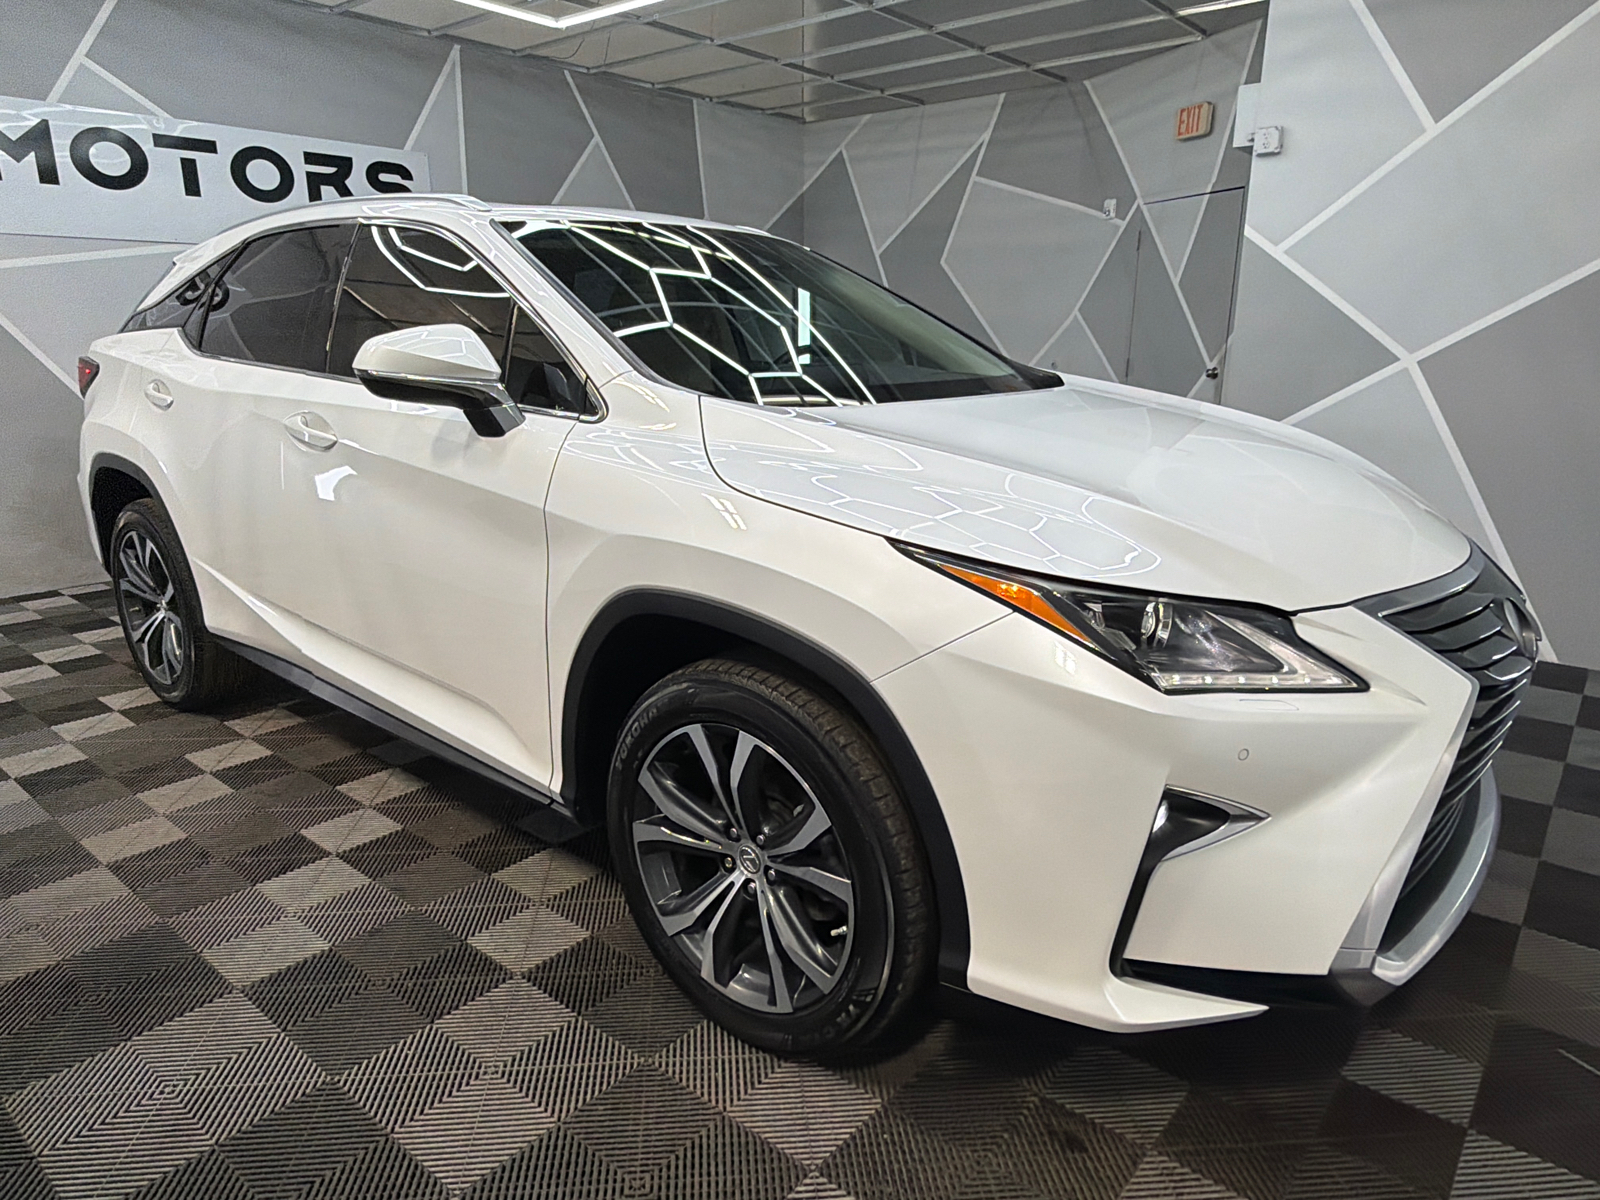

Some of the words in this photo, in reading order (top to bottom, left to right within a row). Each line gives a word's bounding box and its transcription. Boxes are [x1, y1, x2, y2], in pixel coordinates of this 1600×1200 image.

[1177, 103, 1204, 137] EXIT
[0, 118, 414, 204] MOTORS
[615, 699, 668, 771] YOKOHA
